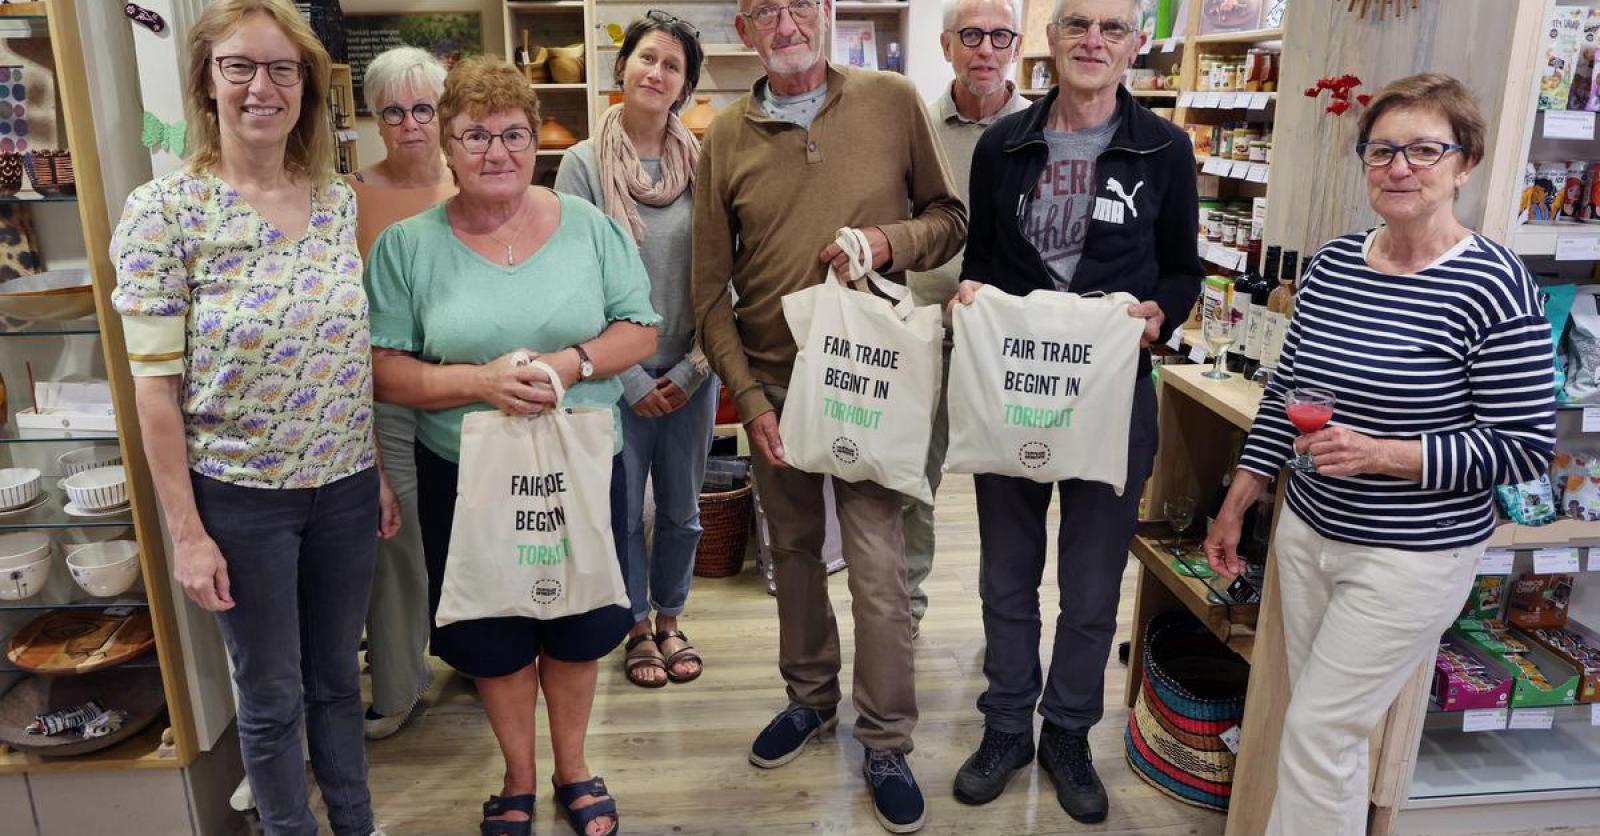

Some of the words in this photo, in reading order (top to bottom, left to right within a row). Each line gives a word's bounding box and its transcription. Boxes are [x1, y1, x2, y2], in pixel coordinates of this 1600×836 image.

[823, 335, 851, 359] FAIR
[855, 344, 900, 369] TRADE
[1002, 337, 1036, 360] FAIR
[1041, 341, 1093, 365] TRADE
[824, 367, 870, 395] BEGINT
[873, 379, 890, 400] IN
[1003, 370, 1060, 397] BEGINT
[1065, 376, 1081, 397] IN
[823, 397, 883, 430] TORHOUT
[1003, 403, 1074, 429] TORHOUT
